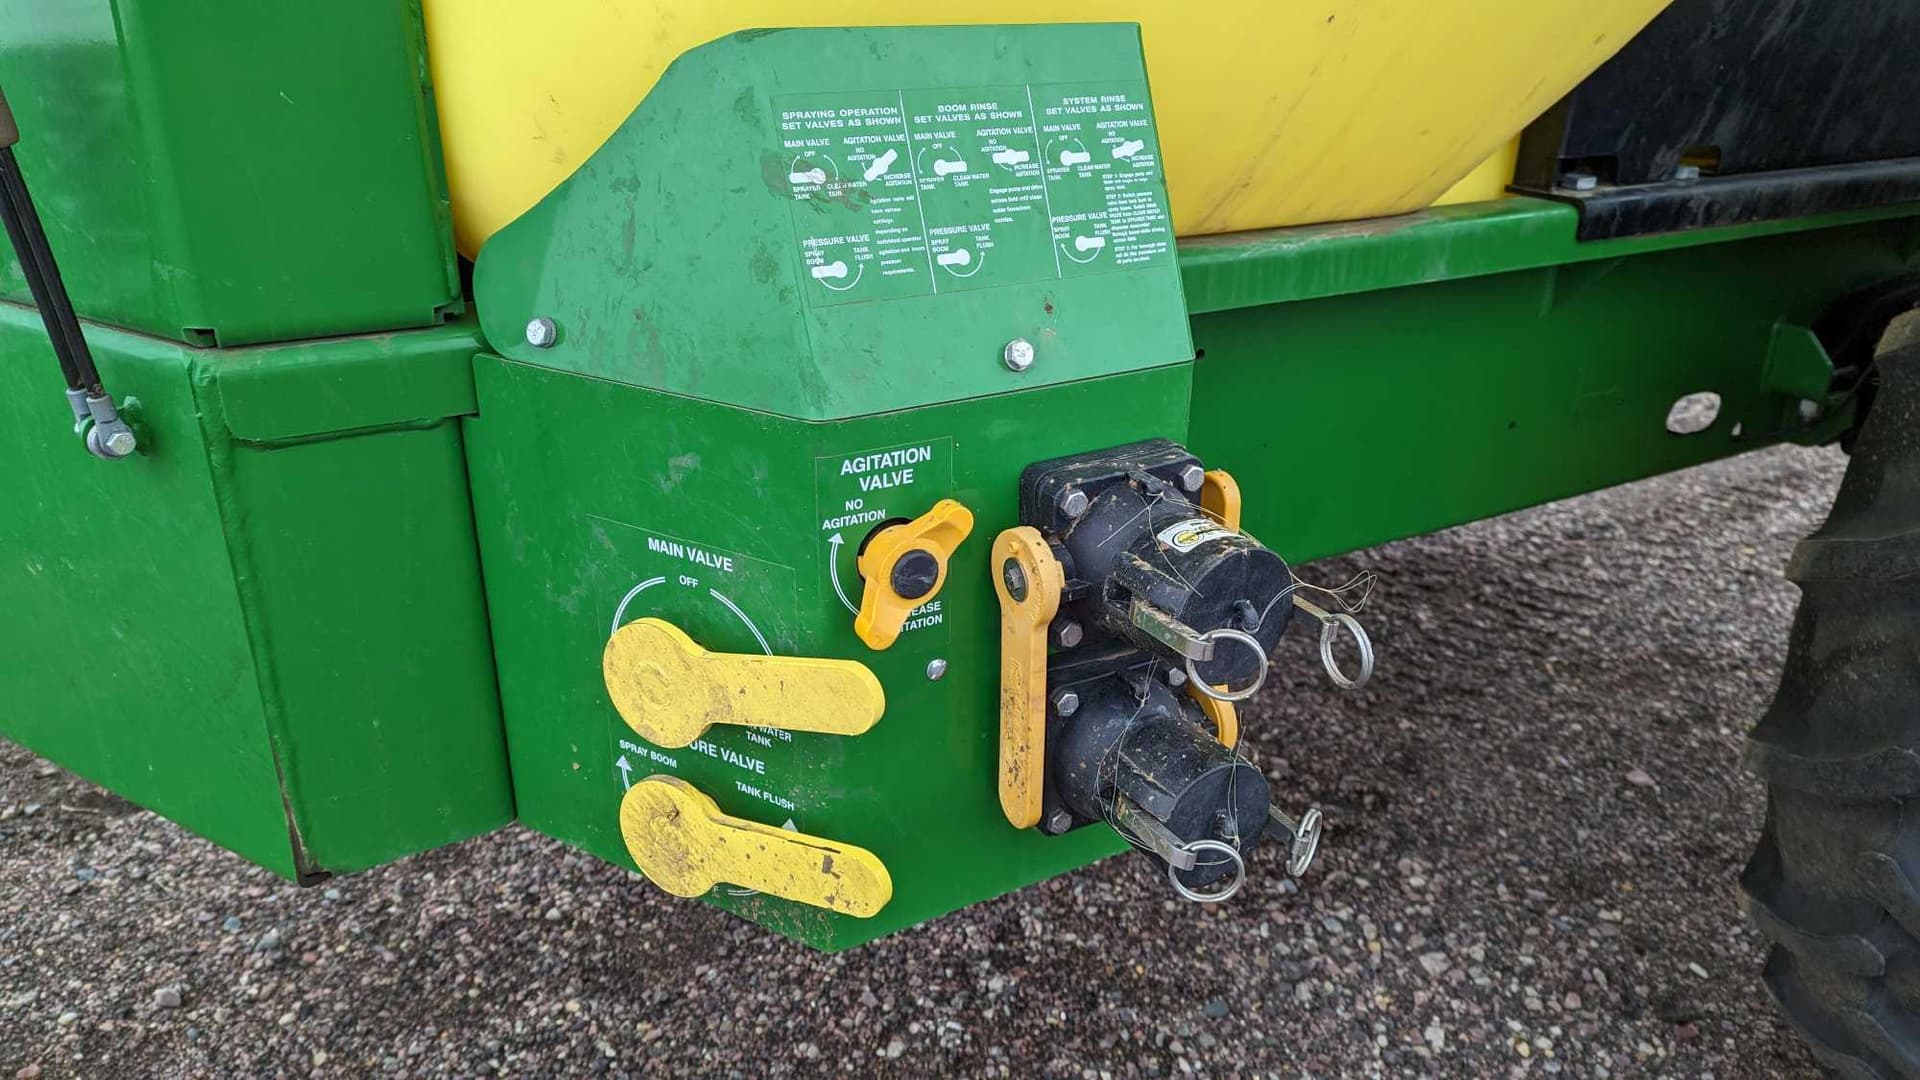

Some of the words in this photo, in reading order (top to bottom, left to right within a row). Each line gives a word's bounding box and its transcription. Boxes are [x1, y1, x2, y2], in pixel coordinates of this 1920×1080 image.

[1063, 97, 1097, 105] SYSTEM
[1100, 95, 1126, 103] RINSE
[782, 110, 835, 120] SPRAYING
[840, 107, 898, 117] OPERATION
[938, 104, 967, 112] BOOM
[970, 103, 998, 111] RINSE
[1046, 107, 1062, 115] SET
[1066, 106, 1097, 114] VALVES
[1114, 103, 1144, 111] SHOWN
[782, 122, 801, 130] SET
[805, 120, 843, 129] VALVES
[848, 119, 861, 127] AS
[866, 117, 901, 126] SHOWN
[914, 115, 933, 123] SET
[935, 114, 970, 122] VALVES
[974, 112, 987, 120] AS
[990, 111, 1023, 119] SHOWN
[976, 128, 1012, 137] AGITATION
[1012, 126, 1033, 134] VALVE
[1060, 124, 1081, 132] VALVE
[1096, 121, 1129, 129] AGITATION
[843, 136, 881, 145] AGITATION
[883, 134, 906, 143] VALVE
[933, 131, 957, 139] VALVE
[784, 140, 804, 148] MAIN
[805, 138, 831, 147] VALVE
[1051, 214, 1087, 223] PRESSURE
[1087, 212, 1108, 220] VALVE
[929, 226, 968, 236] PRESSURE
[968, 224, 991, 232] VALVE
[803, 237, 845, 248] PRESSURE
[845, 234, 870, 243] VALVE
[805, 250, 824, 258] SPRAY
[840, 446, 932, 476] AGITATION
[859, 468, 914, 492] VALVE
[845, 498, 863, 511] NO
[822, 509, 886, 530] AGITATION
[647, 537, 684, 559] MAIN
[686, 547, 733, 572] VALVE
[679, 575, 699, 588] OFF
[911, 601, 941, 616] EASE
[745, 731, 772, 748] TANK
[619, 739, 648, 757] SPRAY
[650, 751, 678, 769] BOOM
[720, 747, 765, 775] VALVE
[735, 780, 761, 799] TANK
[763, 791, 795, 811] FLUSH
